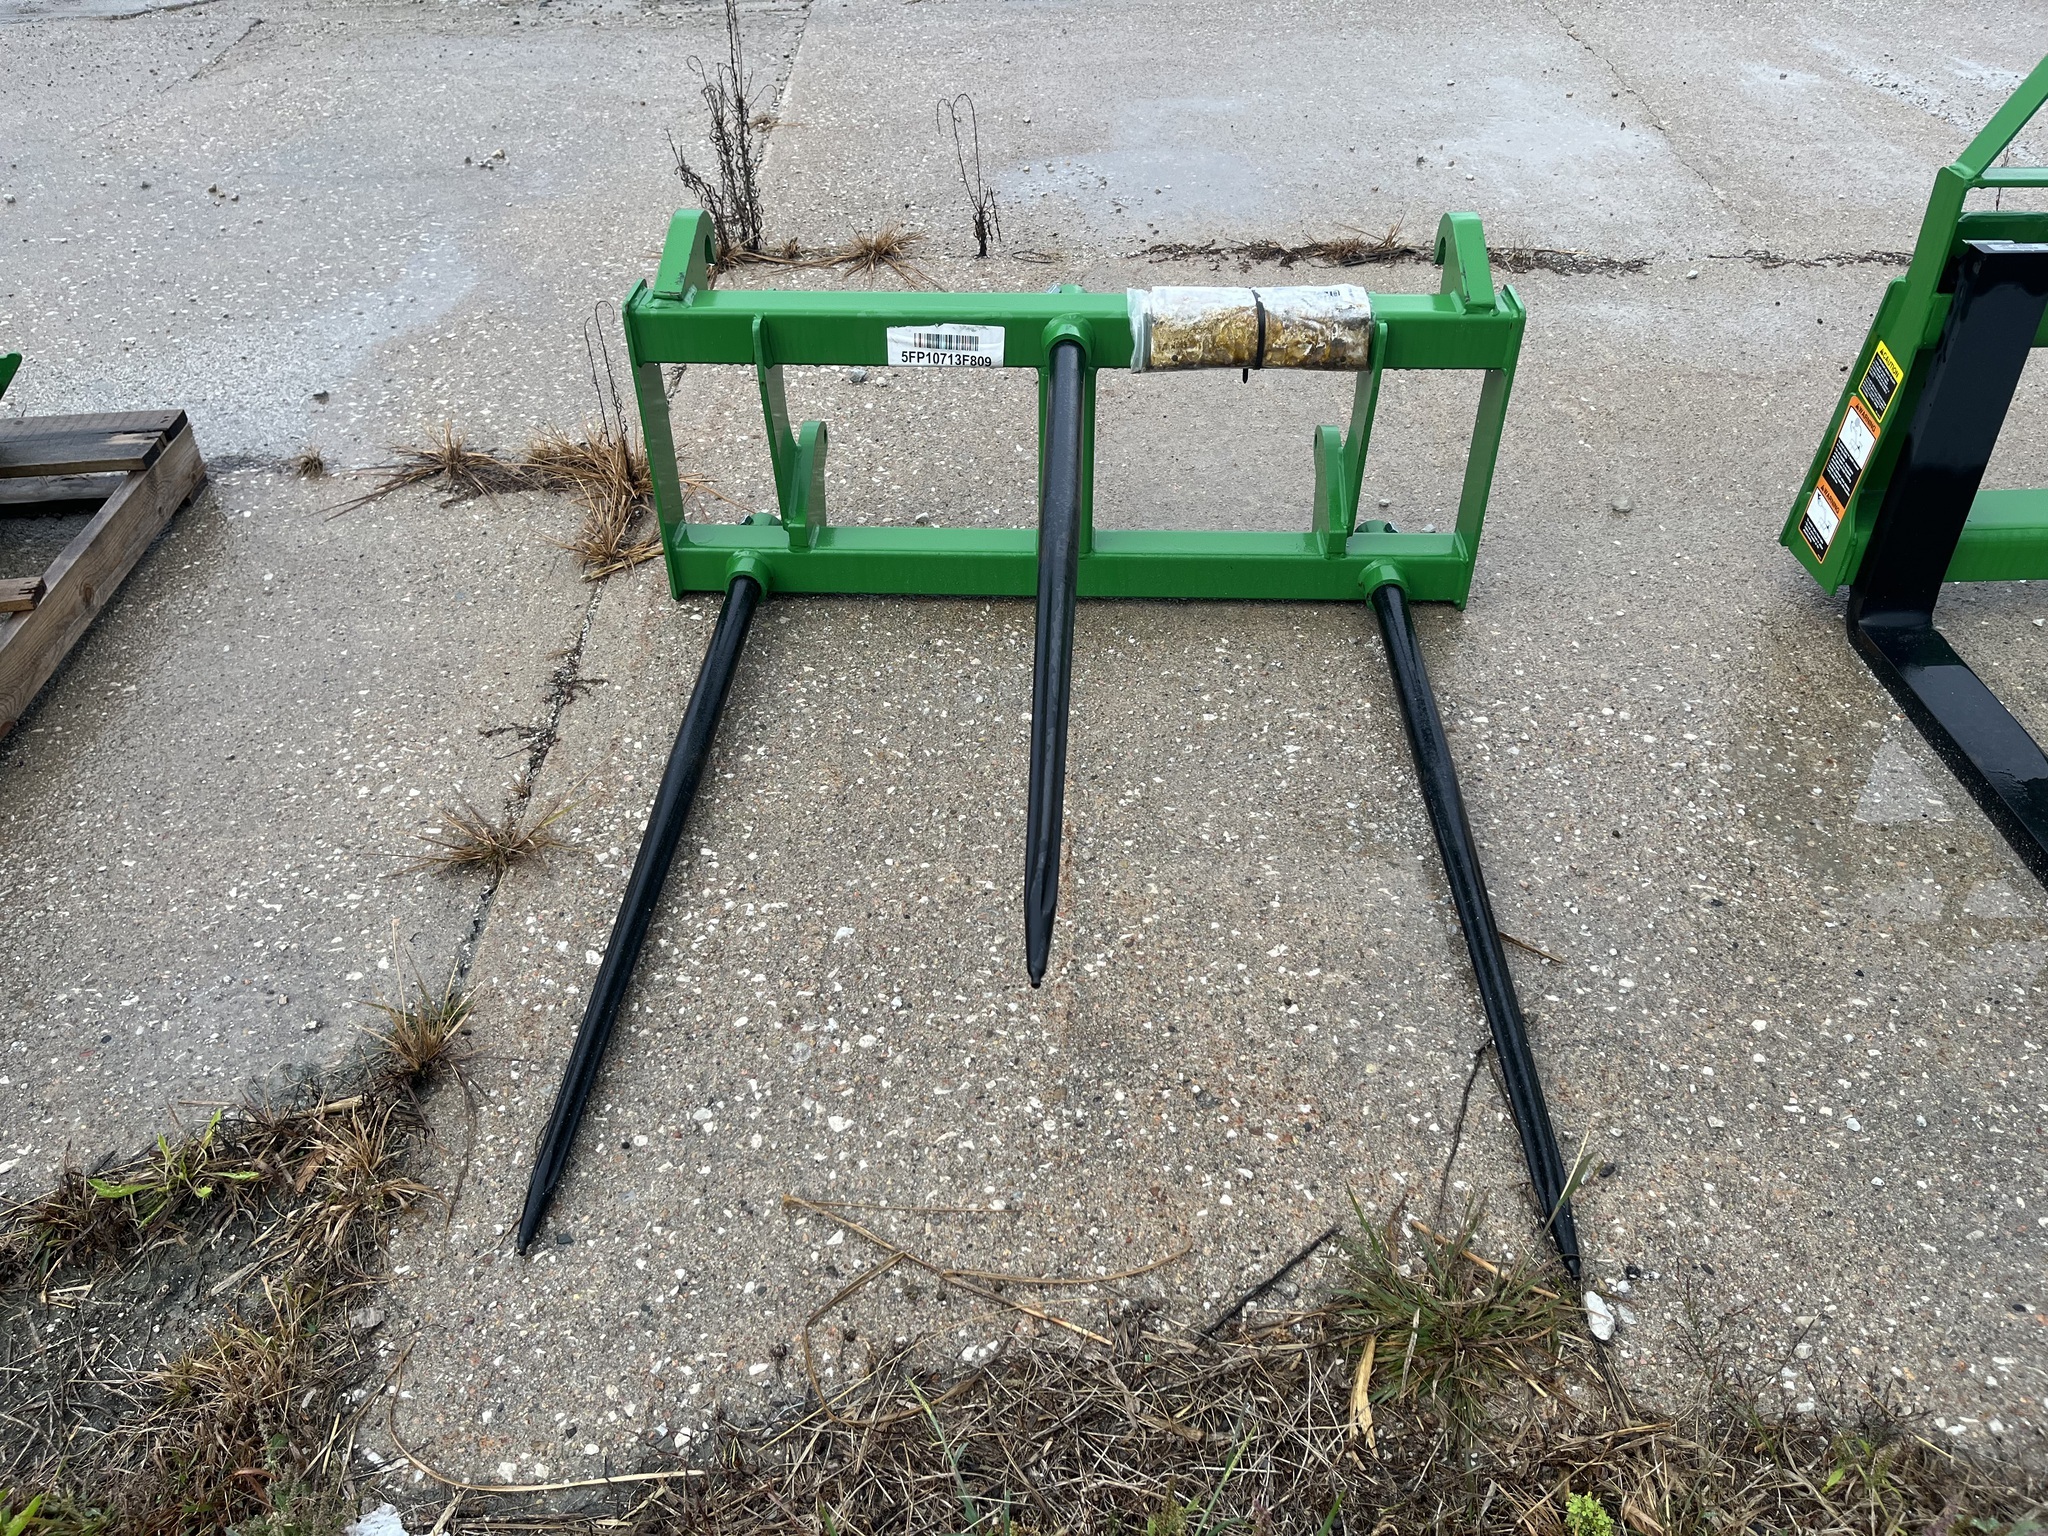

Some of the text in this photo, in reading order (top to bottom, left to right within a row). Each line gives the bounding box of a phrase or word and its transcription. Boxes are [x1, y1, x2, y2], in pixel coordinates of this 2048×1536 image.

[901, 351, 992, 367] 5FP10713F809
[1883, 353, 1899, 378] CAUTION
[1858, 406, 1877, 433] WARNING
[1823, 487, 1840, 514] WARNING
